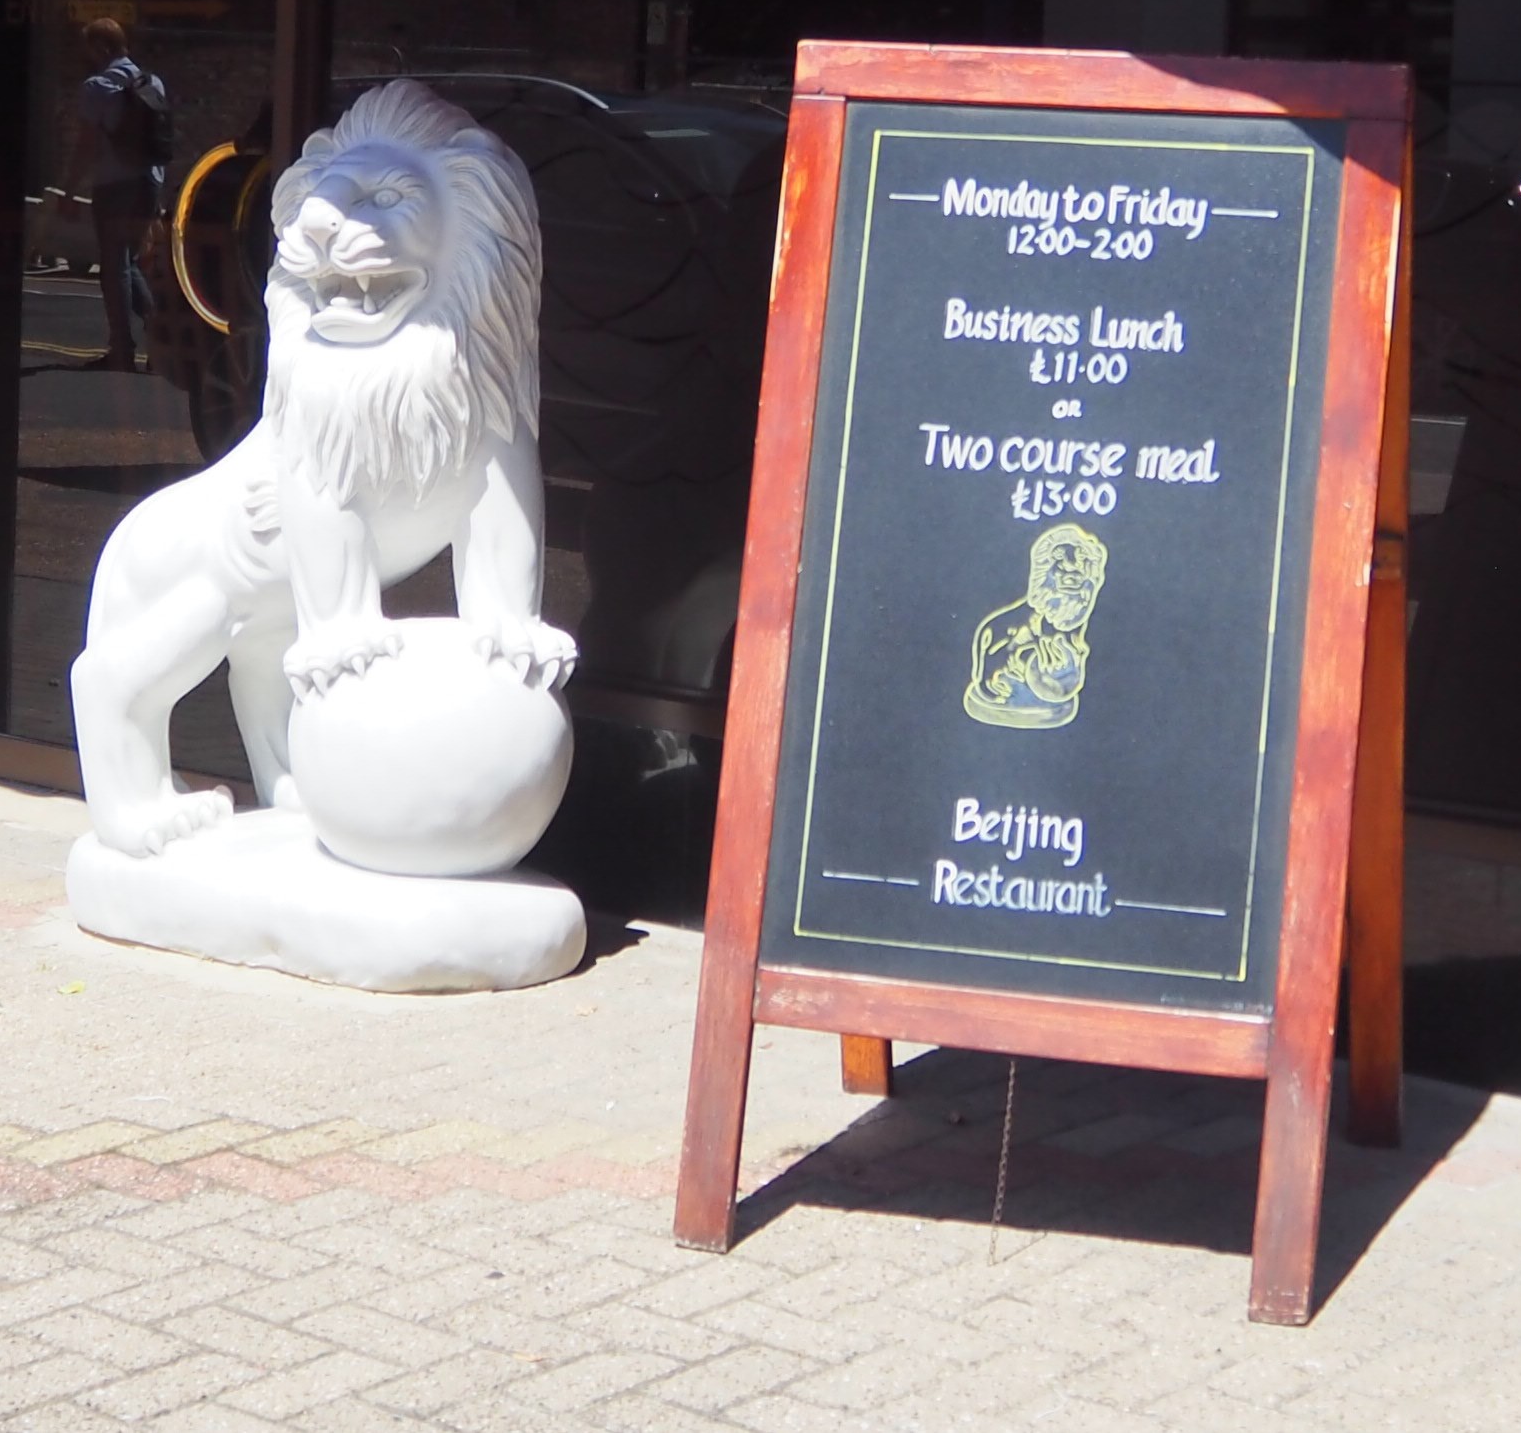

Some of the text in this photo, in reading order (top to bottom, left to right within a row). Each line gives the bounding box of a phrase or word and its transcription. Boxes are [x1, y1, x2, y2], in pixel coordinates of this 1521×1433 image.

[944, 178, 1208, 240] Monday to Friday
[944, 297, 1184, 352] Business Lunch
[918, 423, 1220, 484] Two course meal
[952, 797, 1084, 866] Beijing
[933, 859, 1111, 918] Restaurant
